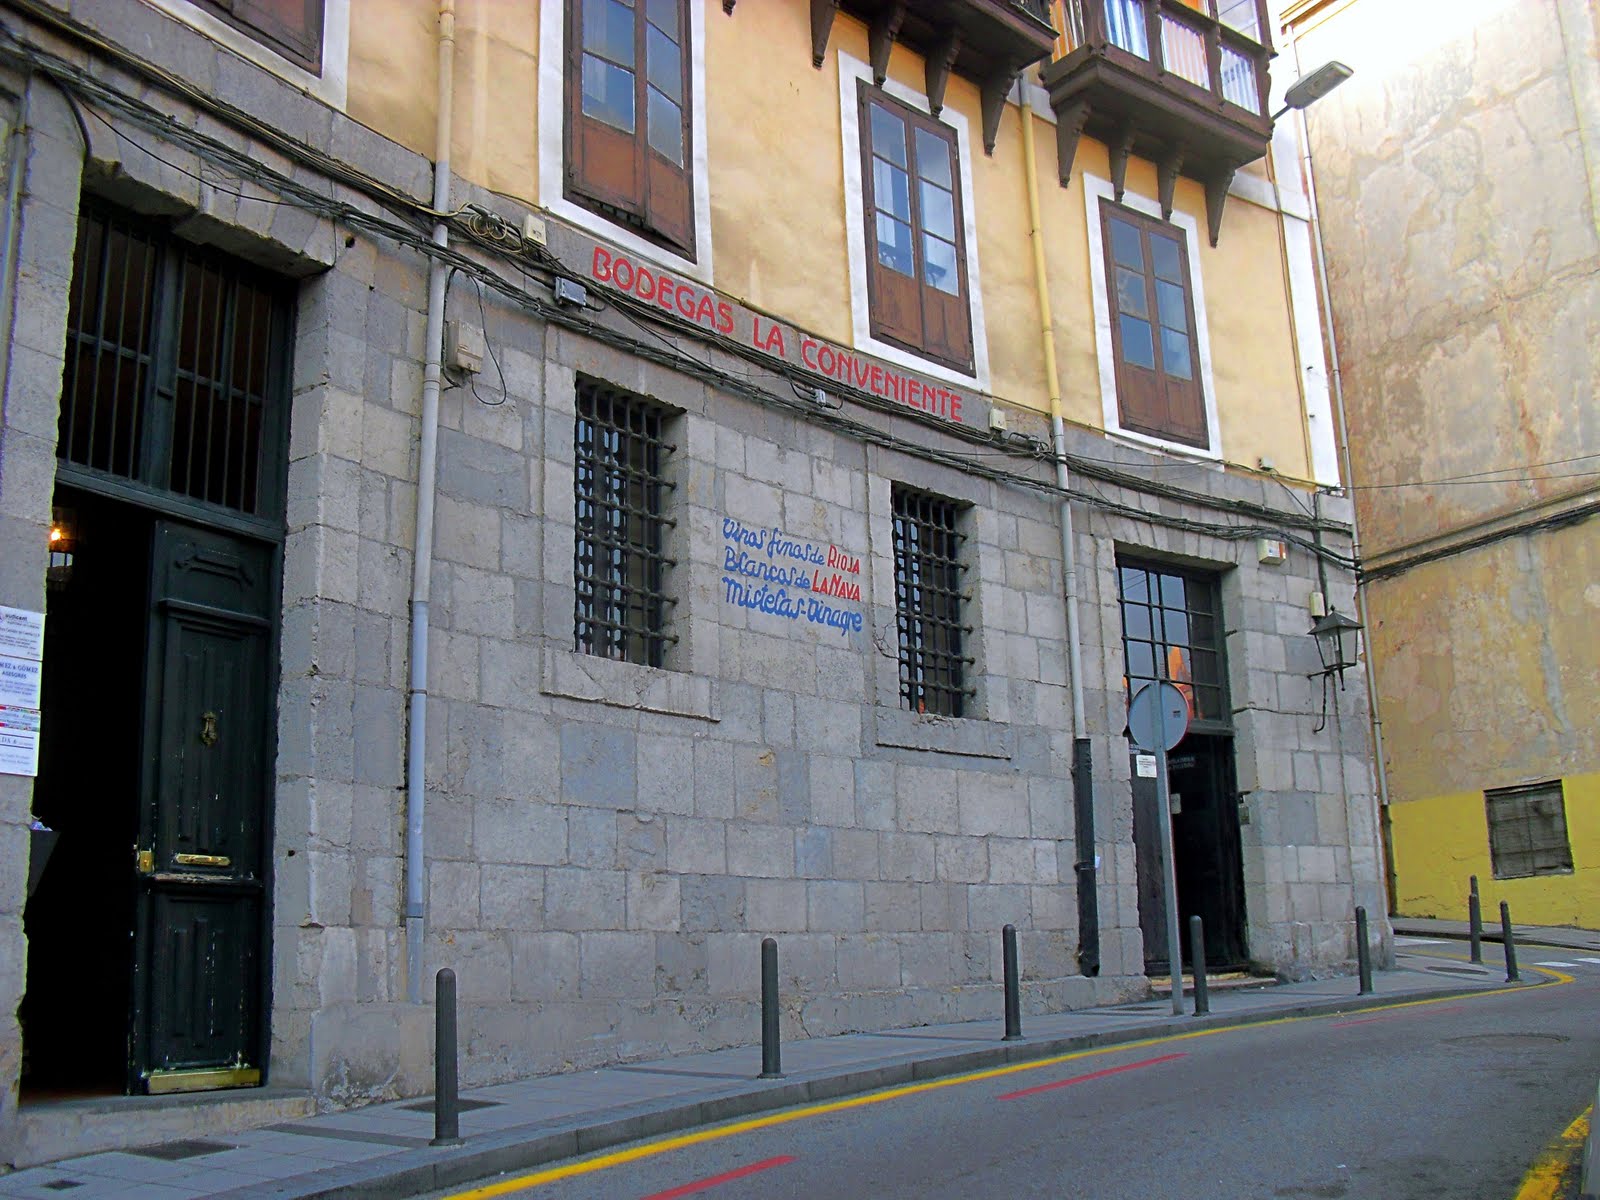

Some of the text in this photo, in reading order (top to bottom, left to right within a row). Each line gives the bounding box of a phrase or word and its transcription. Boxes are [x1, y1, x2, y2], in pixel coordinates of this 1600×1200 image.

[591, 246, 963, 422] BODEGAS LA CONVENIENTE
[722, 517, 861, 575] Vinos finos de RIOJA
[723, 545, 797, 587] Blancos
[794, 570, 811, 590] de
